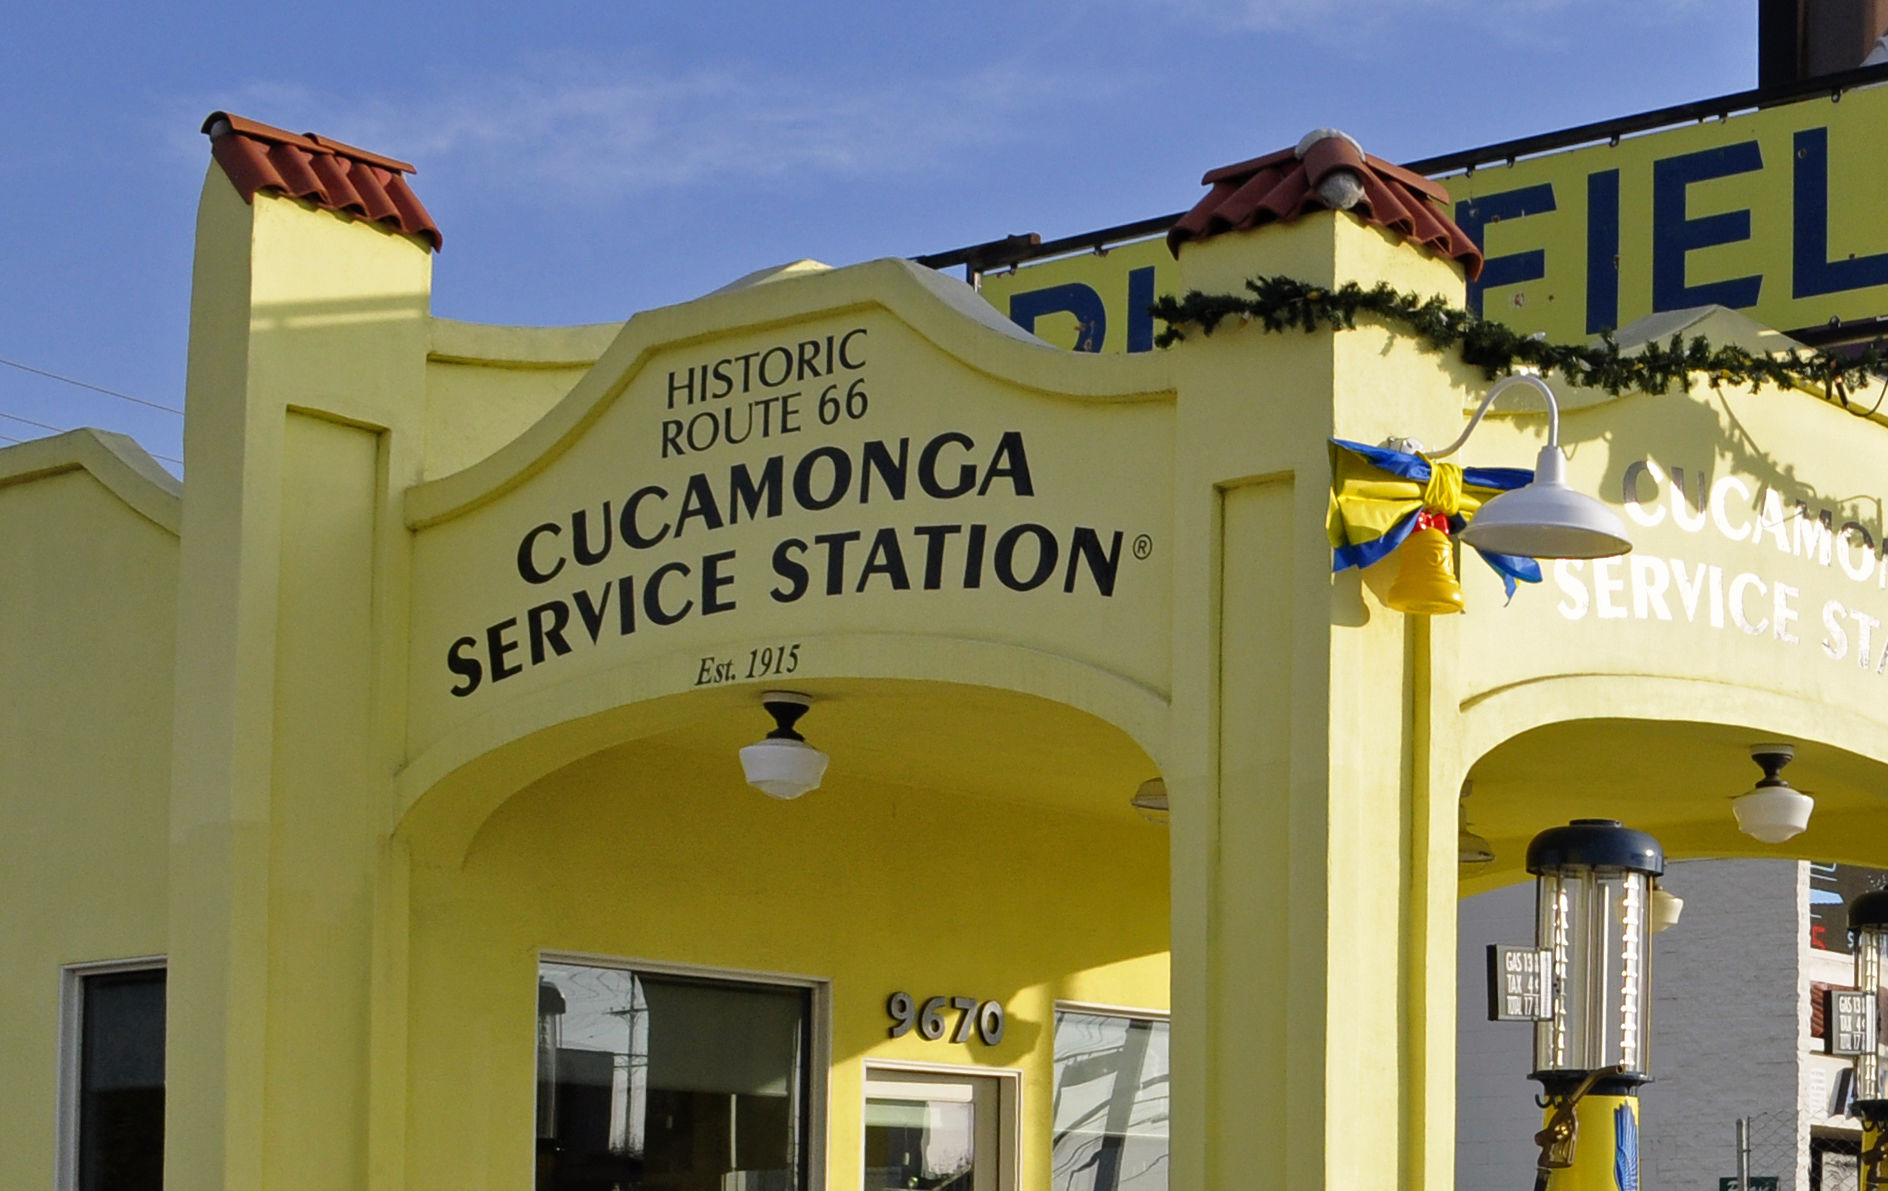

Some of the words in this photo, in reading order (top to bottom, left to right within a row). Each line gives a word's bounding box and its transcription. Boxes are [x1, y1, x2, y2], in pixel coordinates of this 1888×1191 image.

[665, 328, 870, 409] HISTORIC
[660, 396, 802, 458] ROUTE
[817, 377, 870, 429] 66
[516, 431, 1036, 584] CUCAMONGA
[446, 550, 737, 698] SERVICE
[1554, 555, 1800, 645] SERVICE
[694, 656, 737, 687] Est.
[745, 643, 800, 681] 1915
[1506, 952, 1522, 972] GAS
[1506, 974, 1522, 993] TAX
[888, 992, 1005, 1046] 9670
